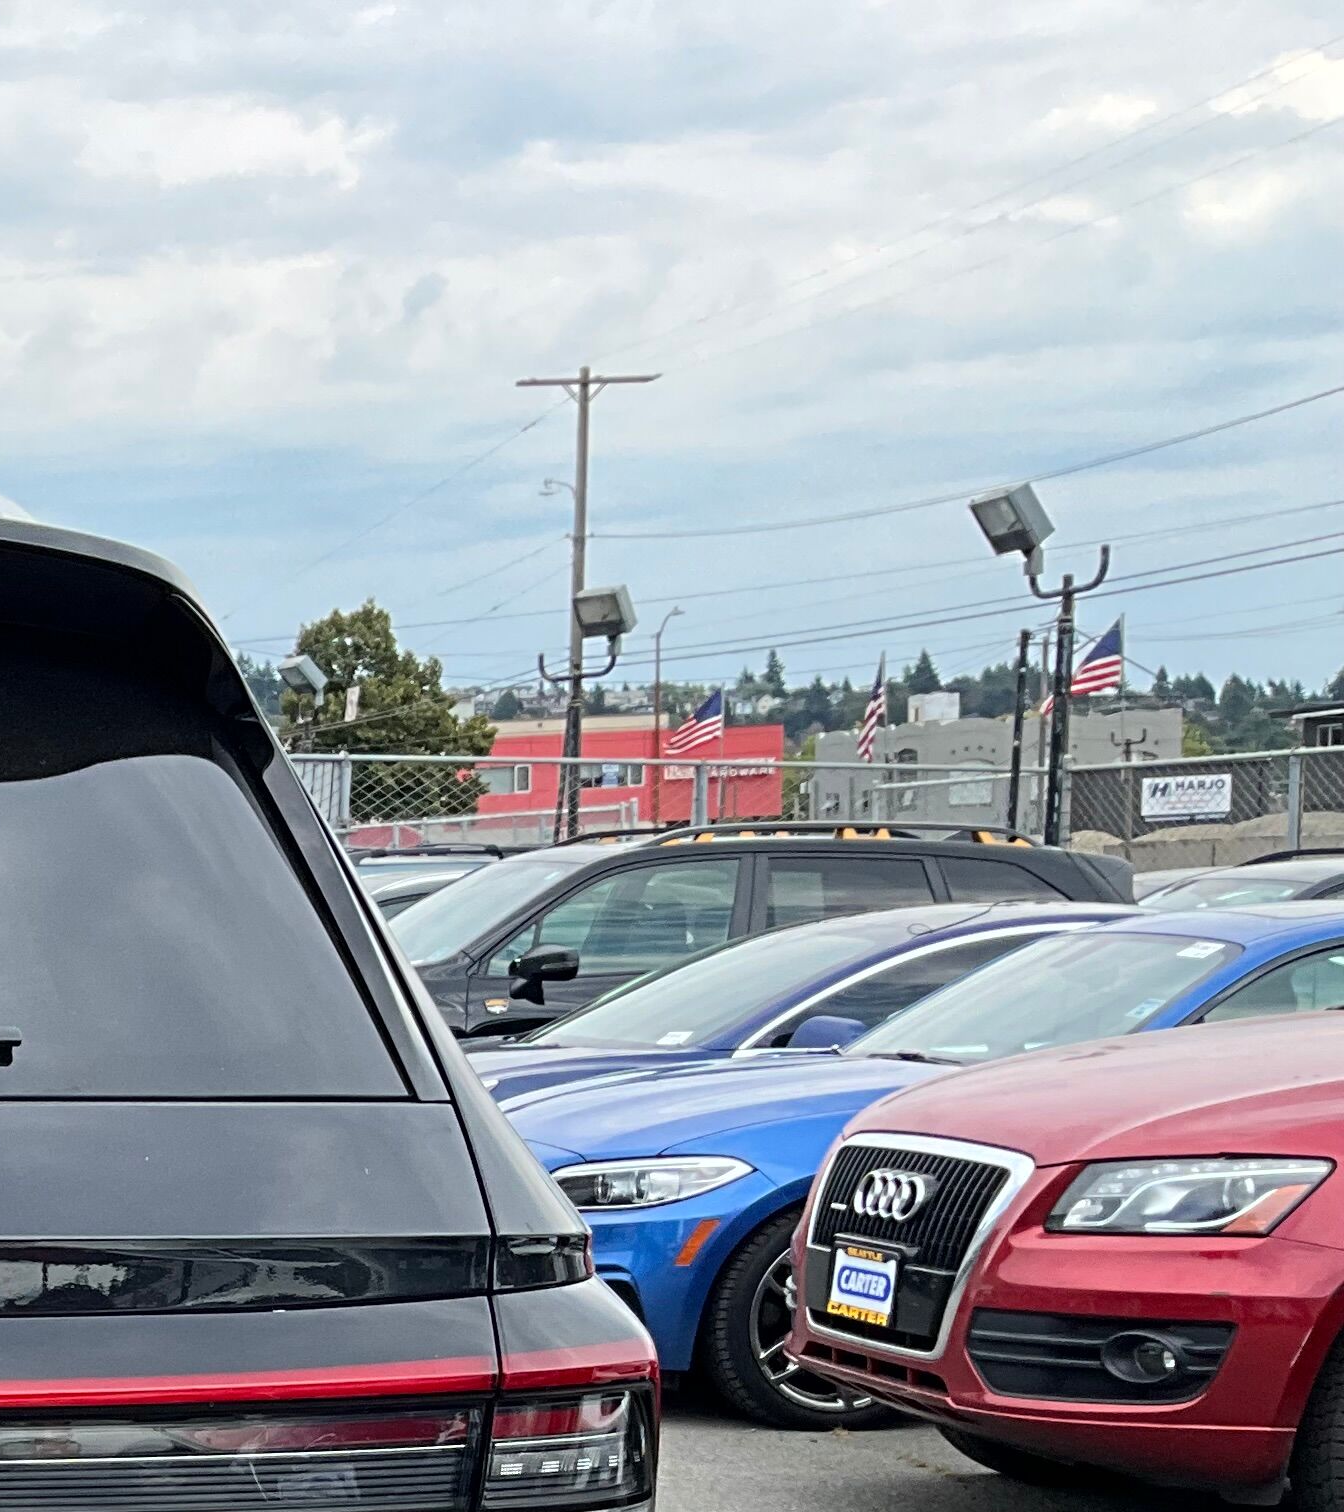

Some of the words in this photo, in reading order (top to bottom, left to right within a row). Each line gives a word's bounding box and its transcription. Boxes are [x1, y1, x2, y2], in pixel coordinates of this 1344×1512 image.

[1175, 778, 1226, 792] HARJO
[846, 1246, 884, 1262] SEATTLE
[839, 1269, 888, 1299] CARTER
[826, 1301, 889, 1328] CARTER
